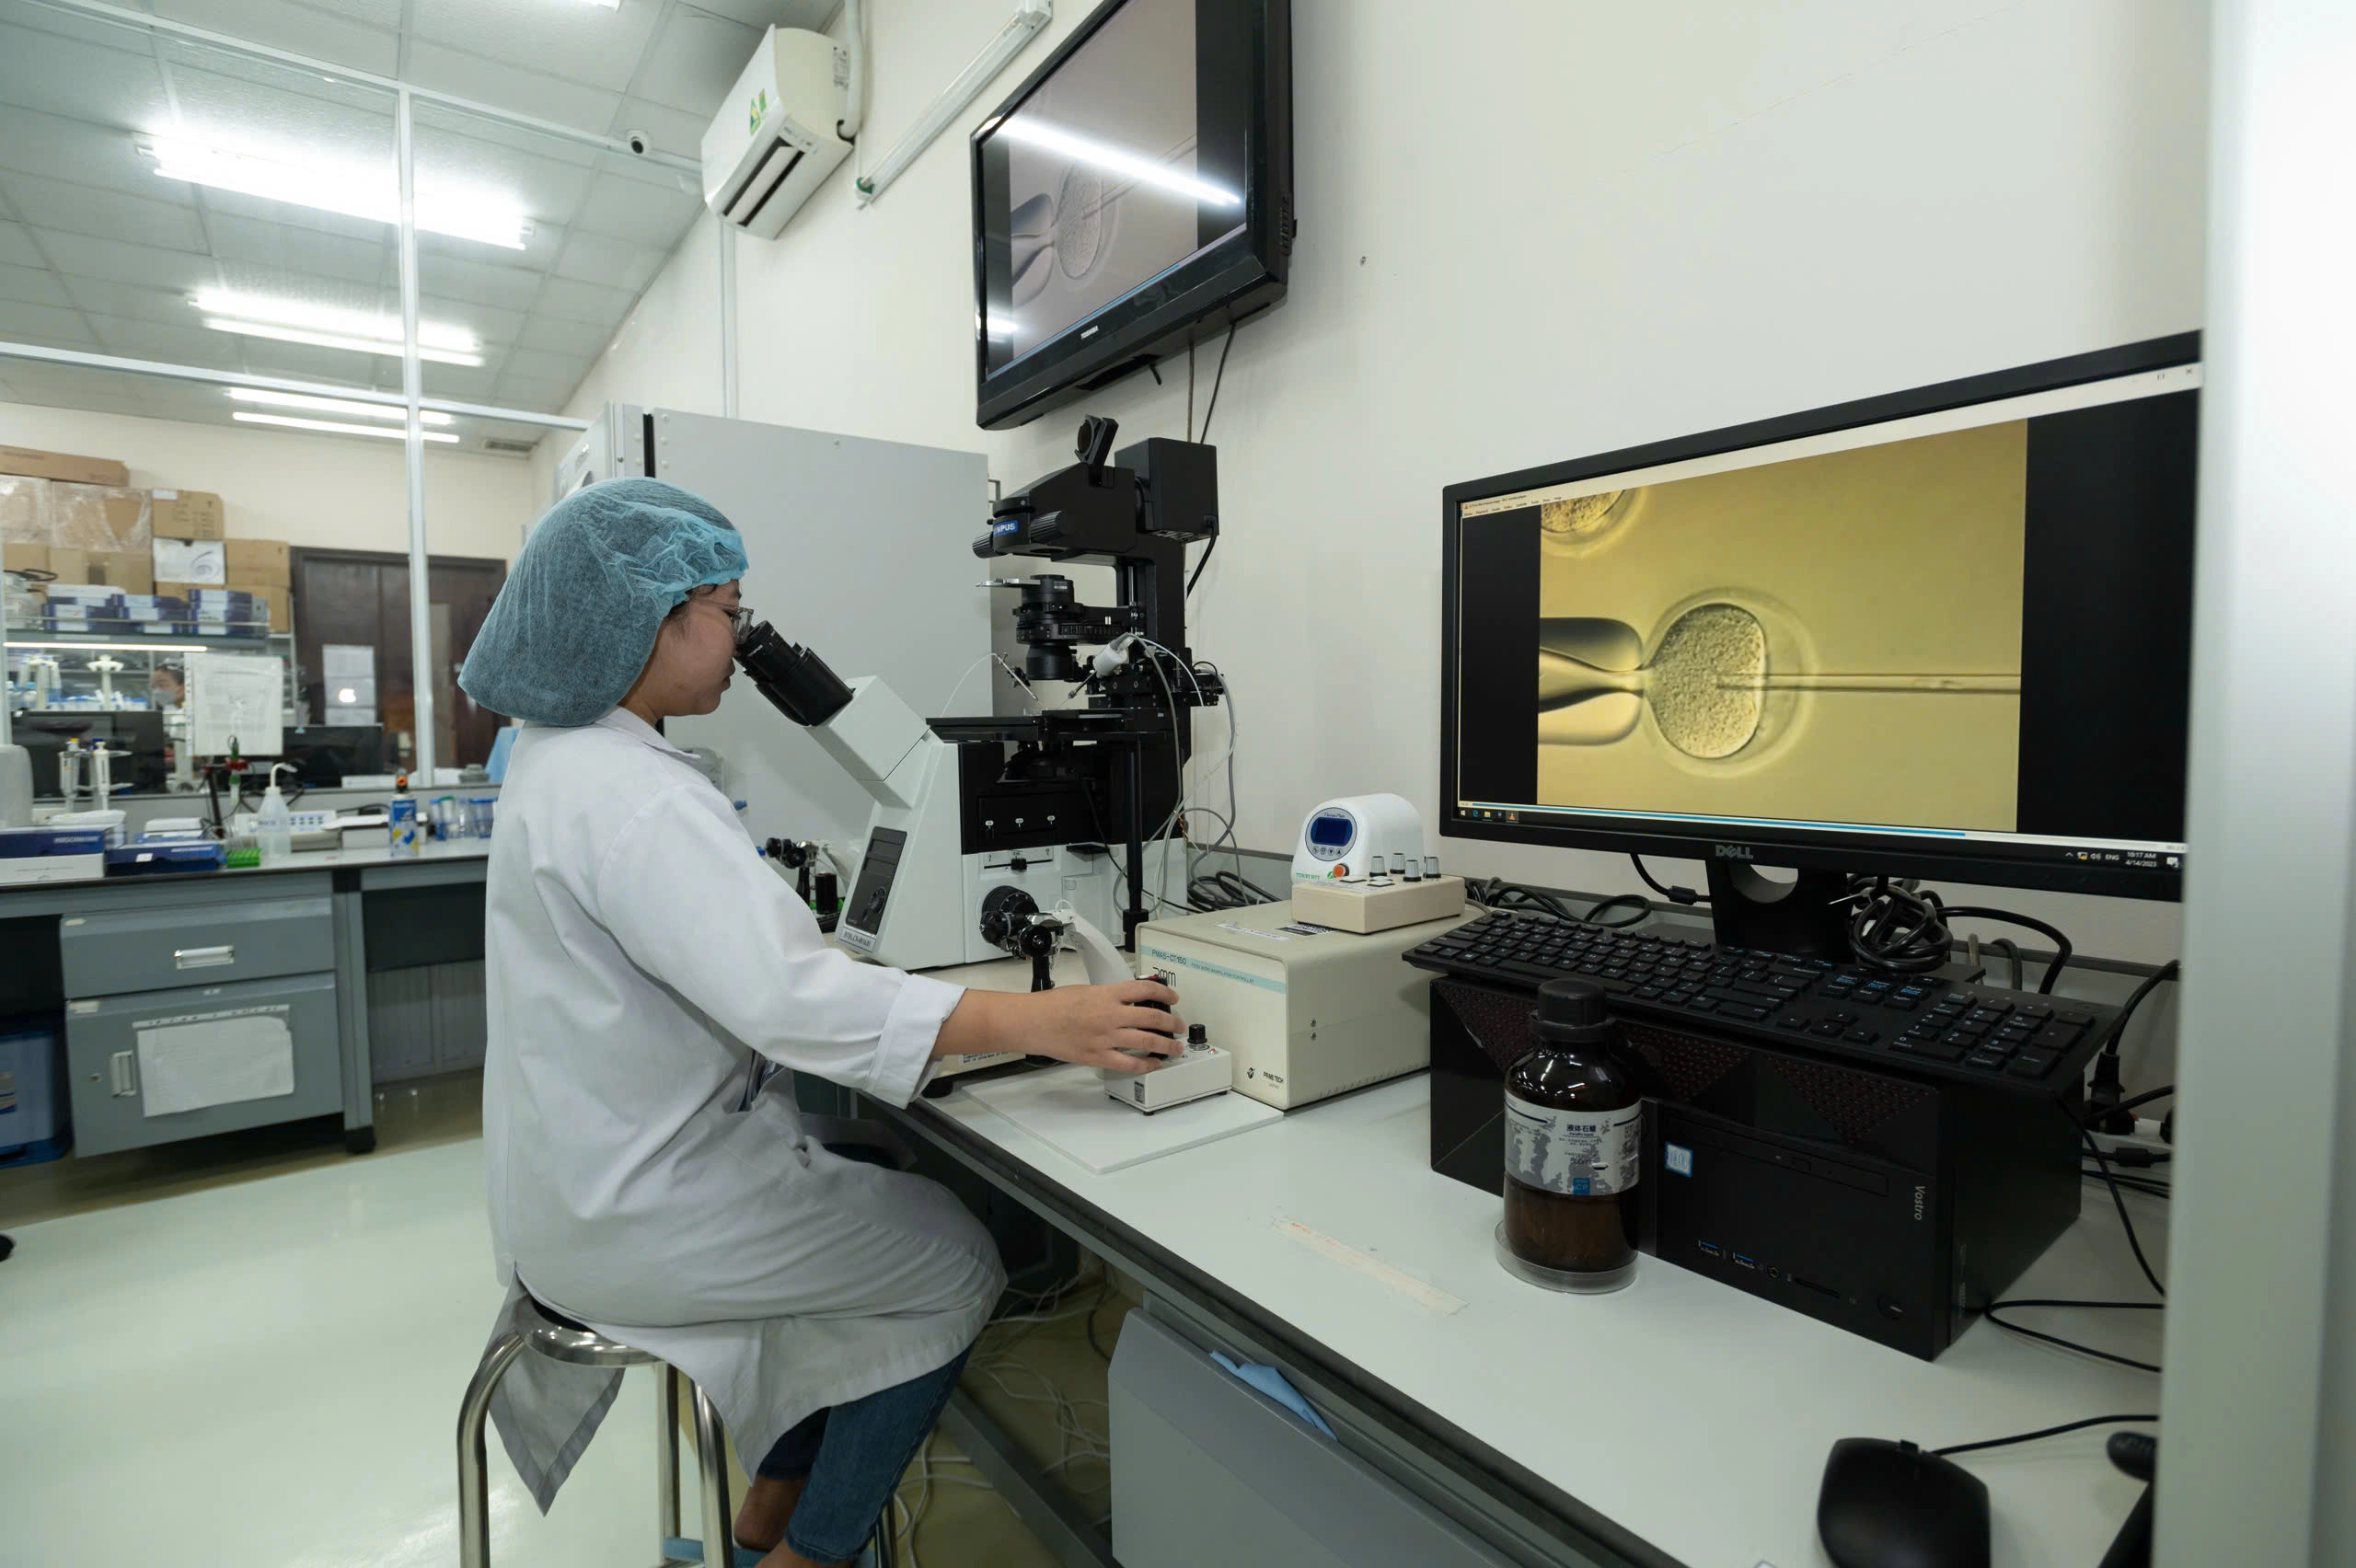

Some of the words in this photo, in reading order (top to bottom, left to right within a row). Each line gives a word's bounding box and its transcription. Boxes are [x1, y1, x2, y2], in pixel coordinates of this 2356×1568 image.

[1715, 845, 1753, 859] DELL
[2126, 859, 2157, 868] 4/14/2023
[1151, 949, 1187, 965] PMAS-CT150
[1914, 1185, 1925, 1221] Vostro
